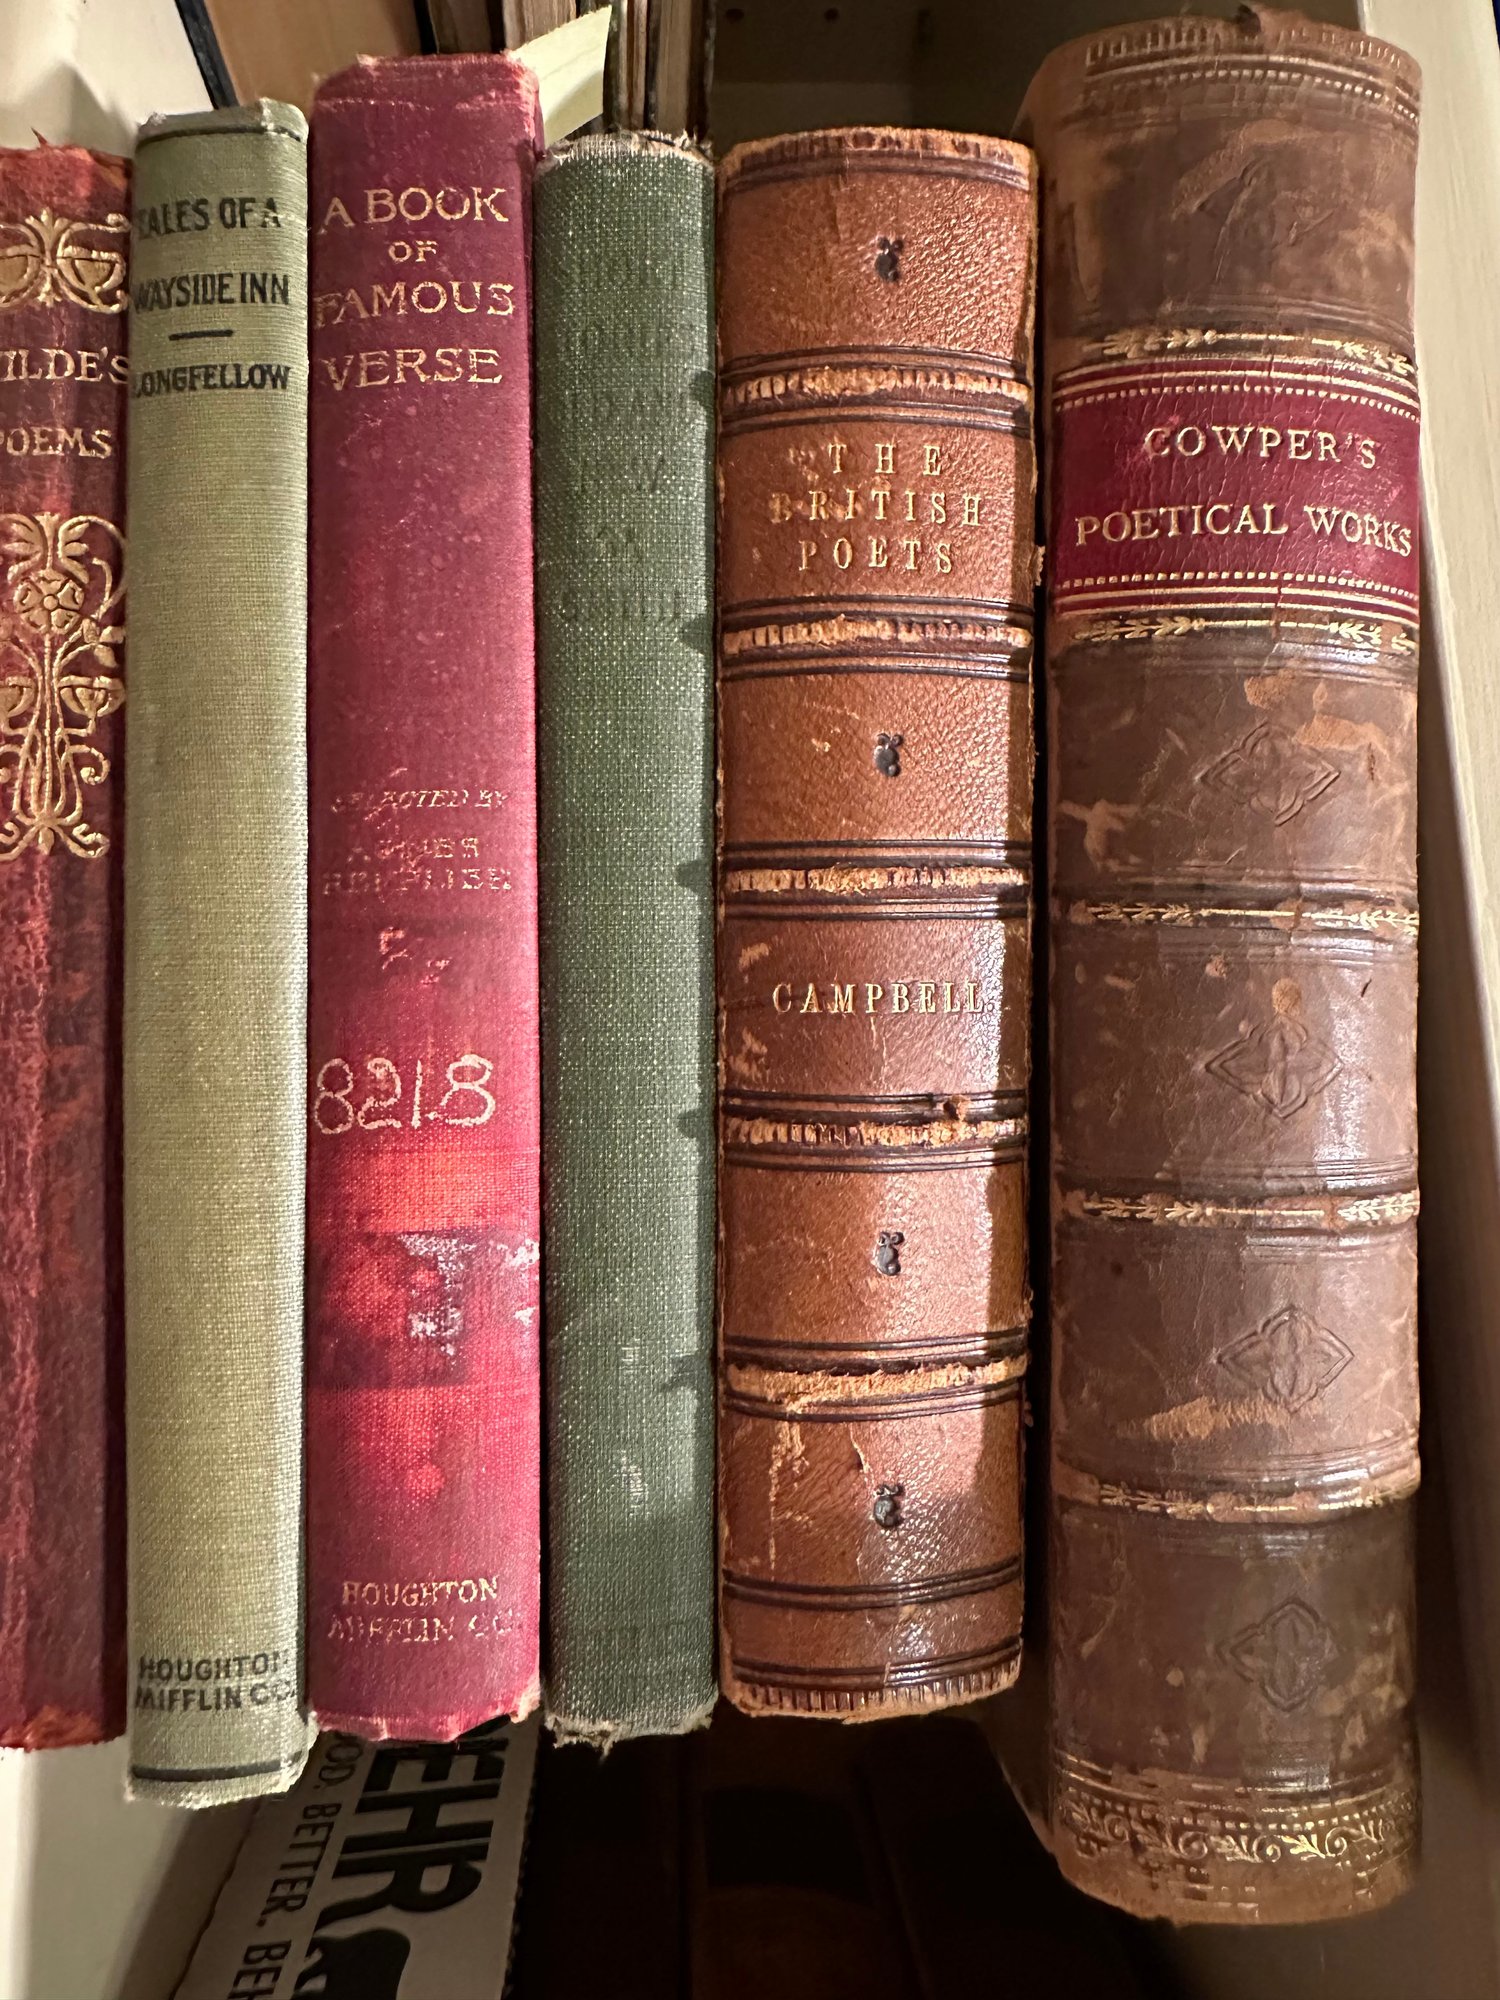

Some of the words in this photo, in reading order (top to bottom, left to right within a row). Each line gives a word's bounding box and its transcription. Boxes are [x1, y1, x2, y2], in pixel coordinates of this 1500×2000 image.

[219, 197, 256, 229] OF
[260, 197, 281, 228] A
[319, 197, 355, 235] A
[364, 186, 509, 225] BOOK
[388, 240, 438, 263] OF
[134, 272, 236, 314] WAYSIDE
[239, 272, 289, 305] INN
[313, 281, 514, 329] FAMOUS
[0, 346, 129, 385] ILDE'S
[319, 348, 503, 391] VERSE
[0, 426, 113, 460] OEMS
[828, 442, 942, 476] THE
[1143, 425, 1377, 470] COWPER'S
[768, 489, 982, 526] BRITISH
[1075, 504, 1290, 547] POETICAL
[1303, 504, 1412, 557] WORKS
[798, 537, 953, 574] POETS
[341, 1575, 499, 1607] HOUGHTON
[134, 1685, 242, 1712] MIFFLIN
